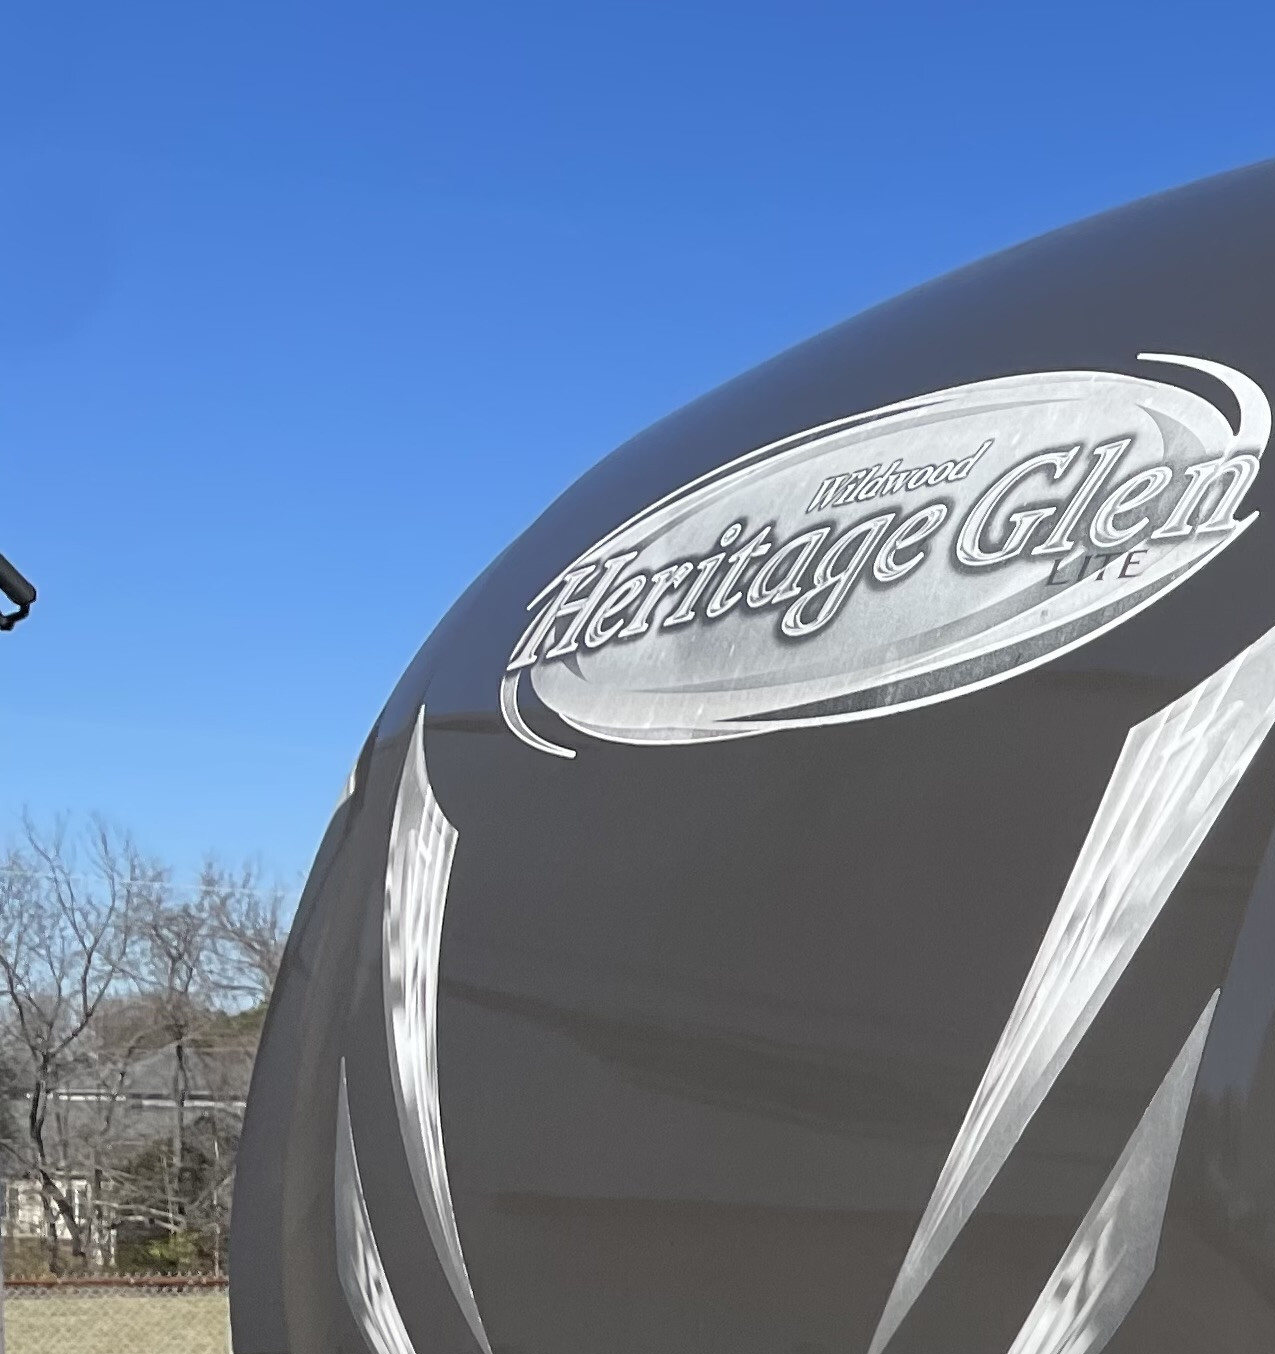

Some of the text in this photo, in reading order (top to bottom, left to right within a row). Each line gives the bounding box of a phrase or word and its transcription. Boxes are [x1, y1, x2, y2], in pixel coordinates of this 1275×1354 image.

[806, 438, 995, 514] Wildwood
[506, 438, 1260, 671] Heritage Glen
[1046, 550, 1148, 586] LITE
